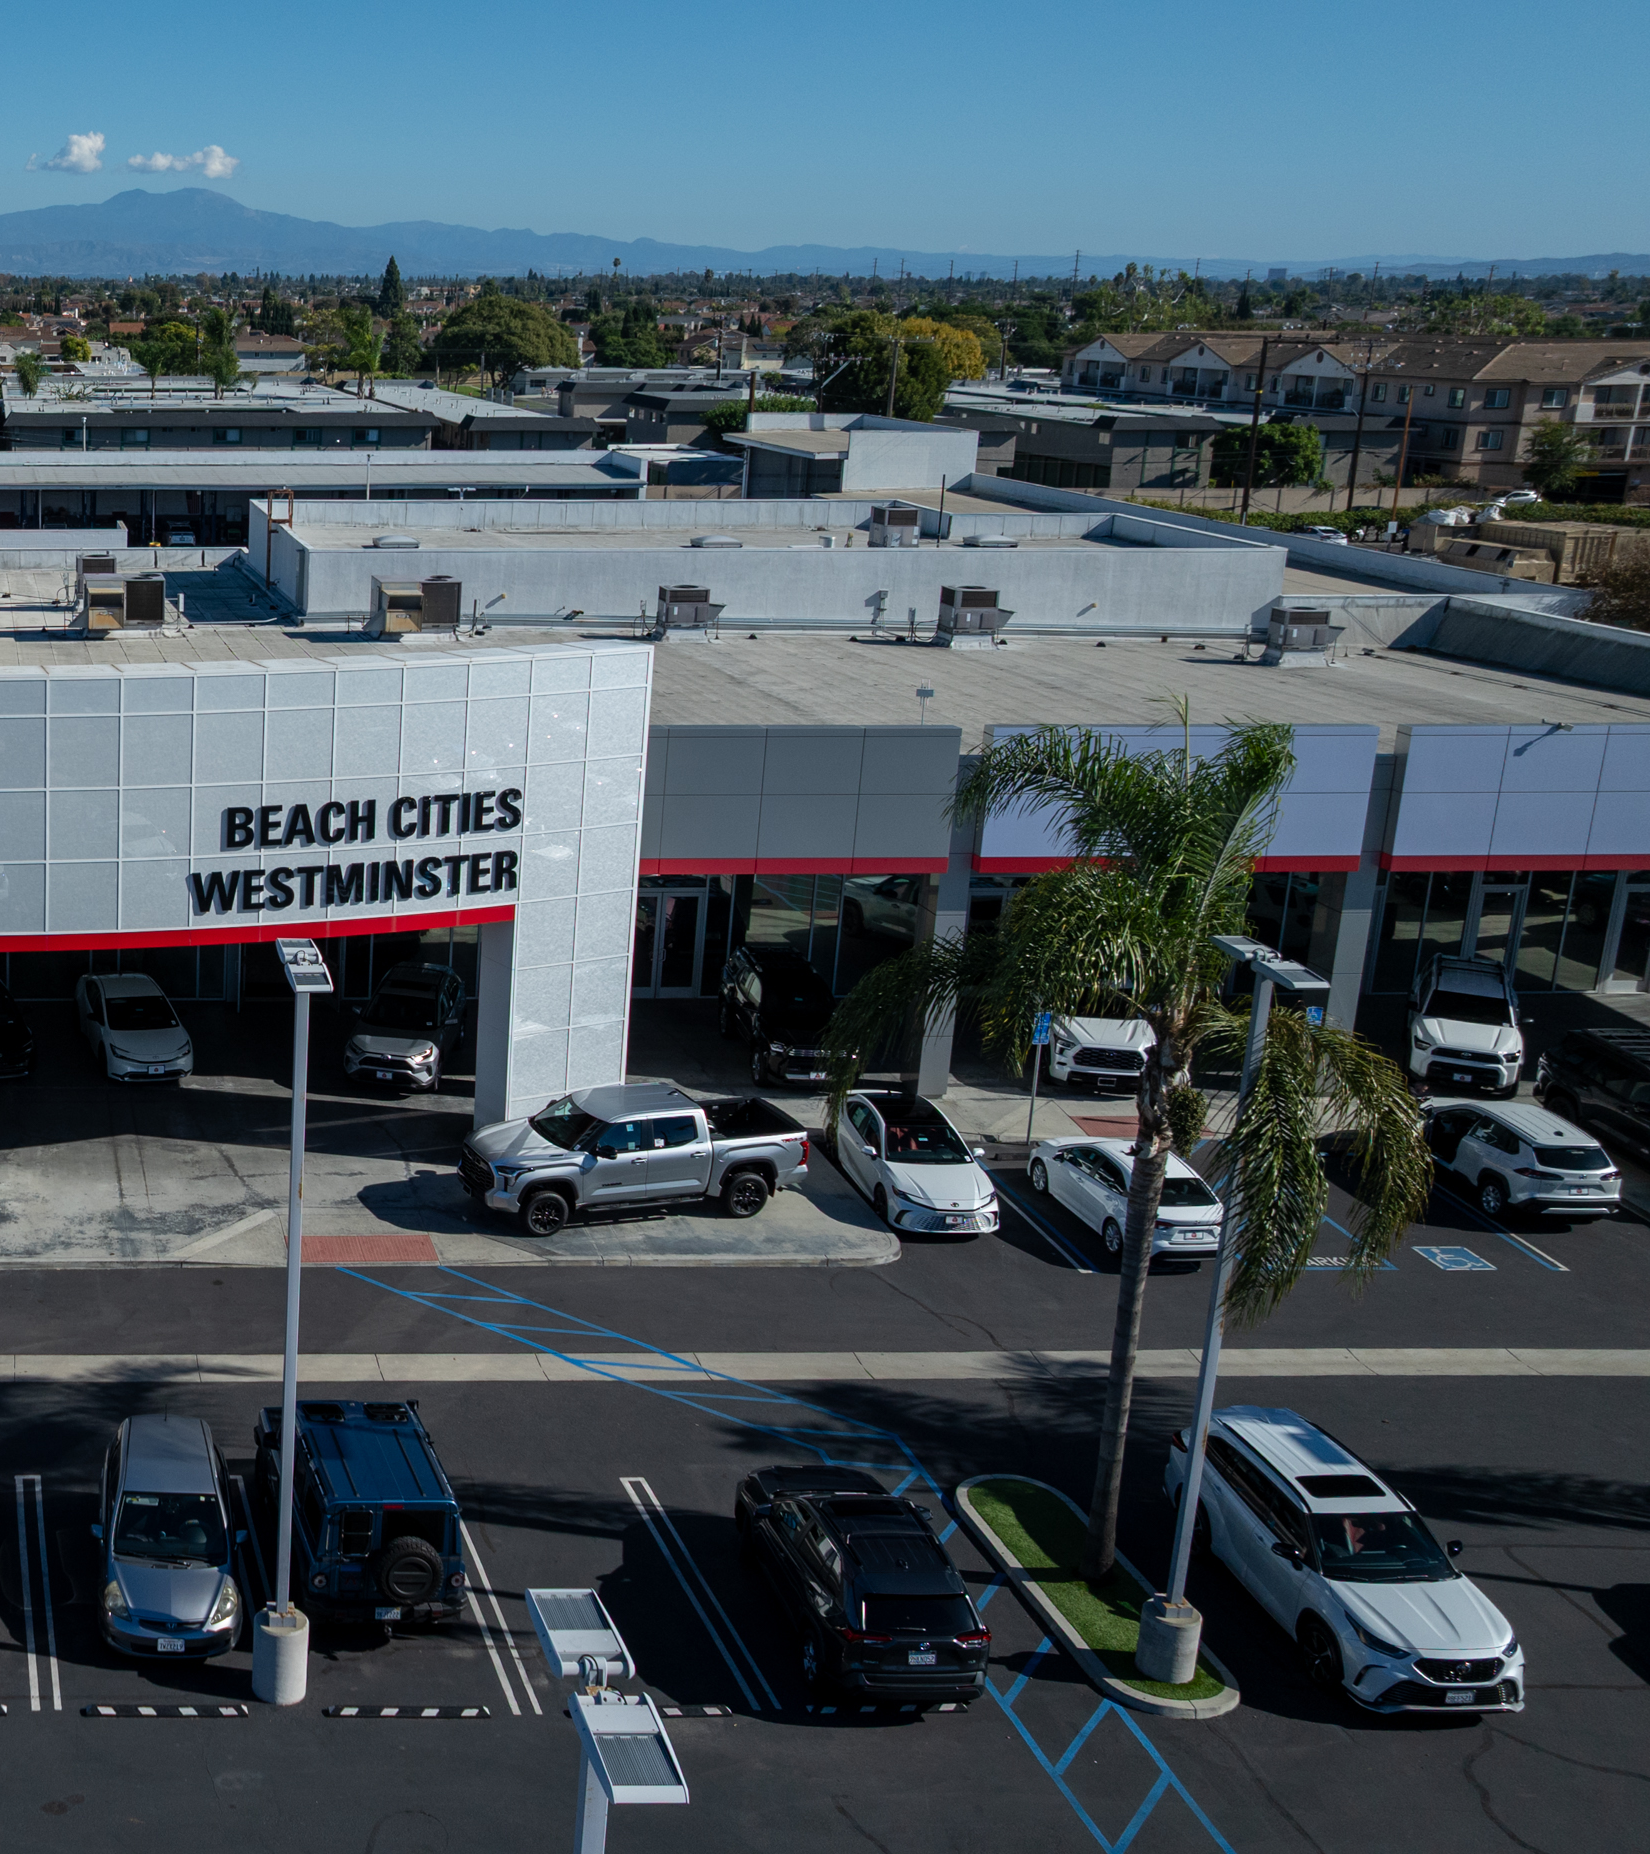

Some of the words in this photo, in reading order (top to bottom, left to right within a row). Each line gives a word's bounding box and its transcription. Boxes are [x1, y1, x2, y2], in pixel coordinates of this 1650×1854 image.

[226, 799, 376, 849] BEACH
[392, 788, 522, 838] CITIES
[192, 850, 518, 913] WESTMINSTER
